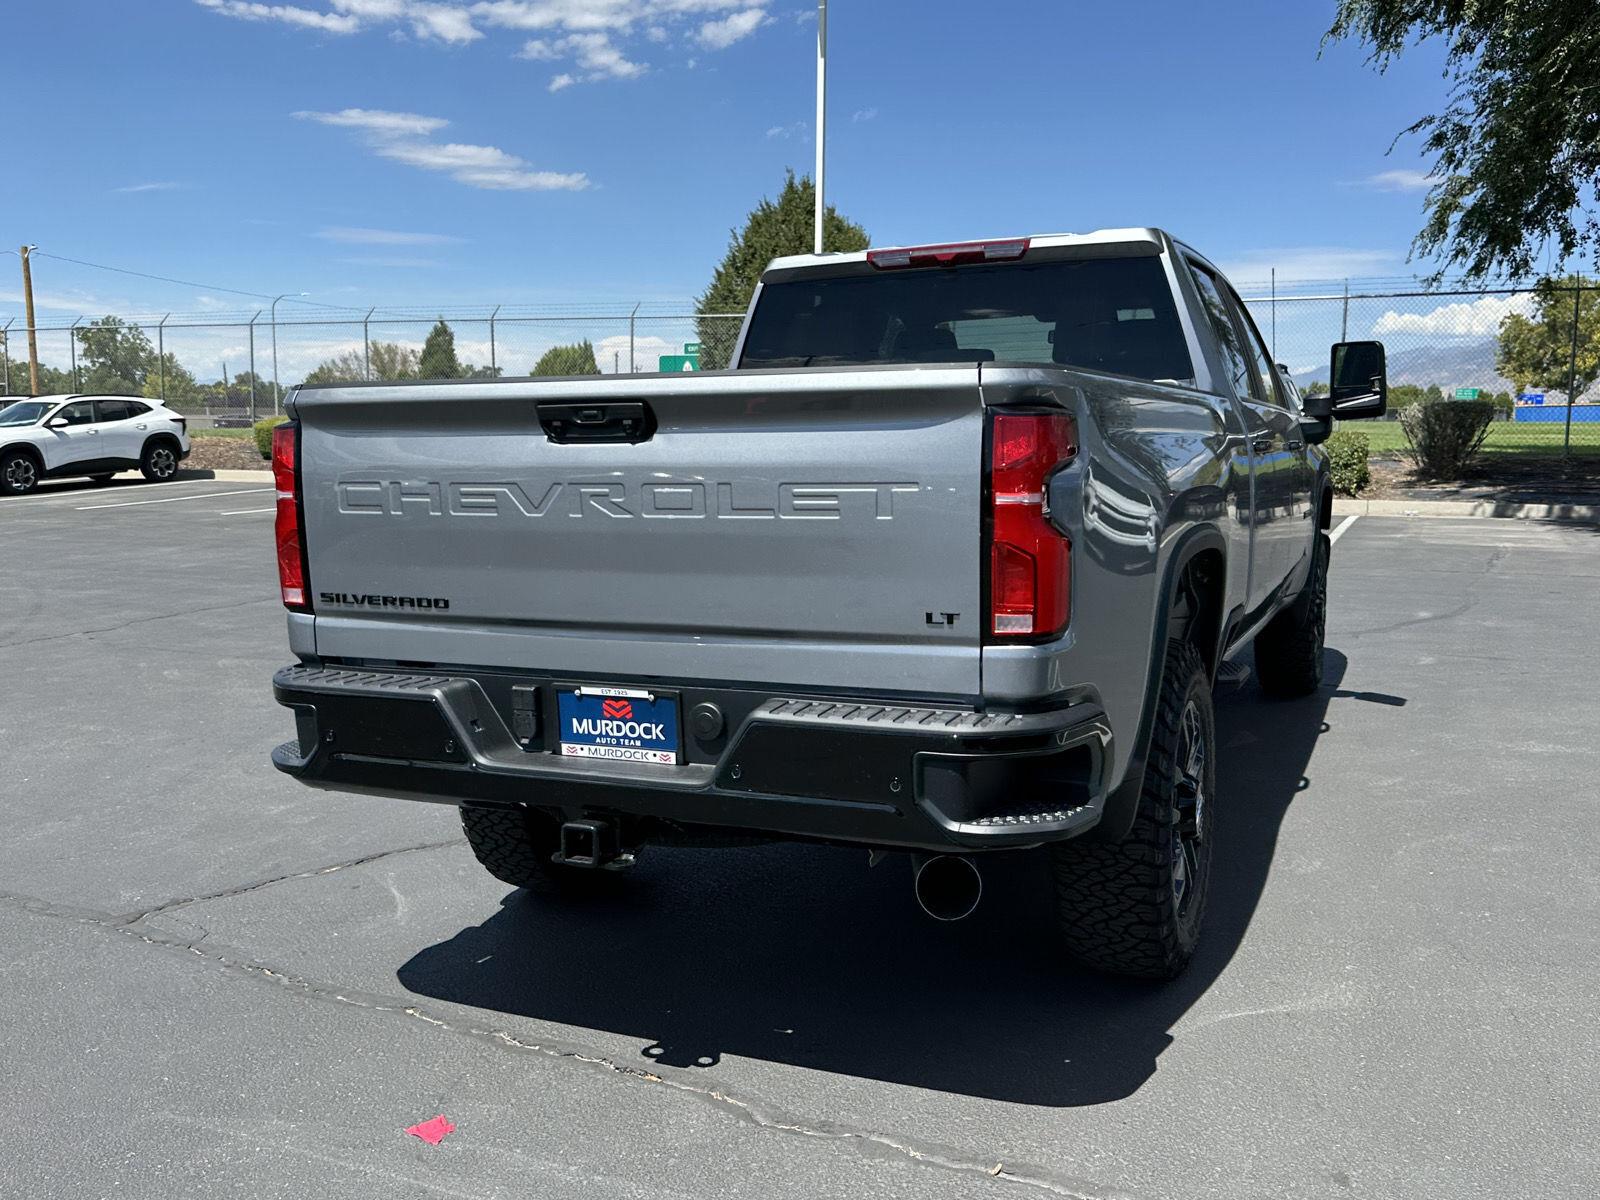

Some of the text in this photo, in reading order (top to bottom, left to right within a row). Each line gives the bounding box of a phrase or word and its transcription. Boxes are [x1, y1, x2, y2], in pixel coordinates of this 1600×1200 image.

[337, 482, 919, 519] CHEVROLET
[320, 592, 449, 609] SILVERADO
[925, 612, 960, 625] LT
[572, 718, 665, 740] MURDOCK
[596, 736, 641, 747] AUTO TEAM
[588, 746, 650, 761] MURDOCK
